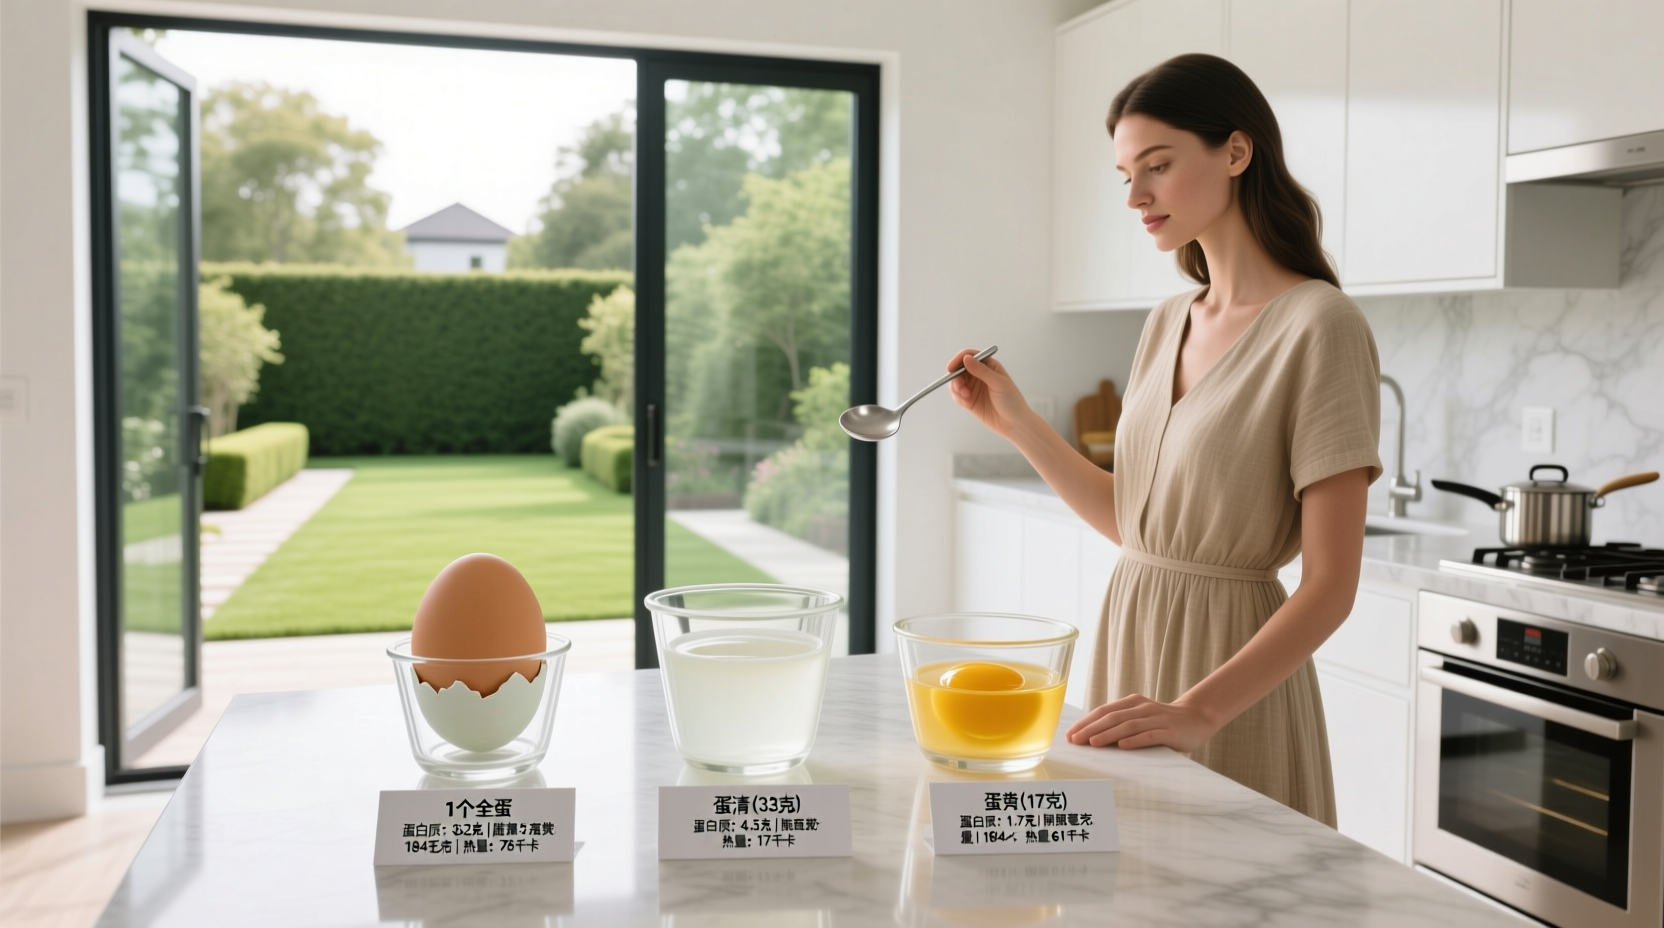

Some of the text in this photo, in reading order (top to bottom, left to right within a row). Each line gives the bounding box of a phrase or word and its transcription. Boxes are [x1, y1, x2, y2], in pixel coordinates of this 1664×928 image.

[445, 798, 512, 818] 1个全蛋
[713, 793, 801, 815] 蛋清(33克)
[757, 833, 796, 848] 17千卡
